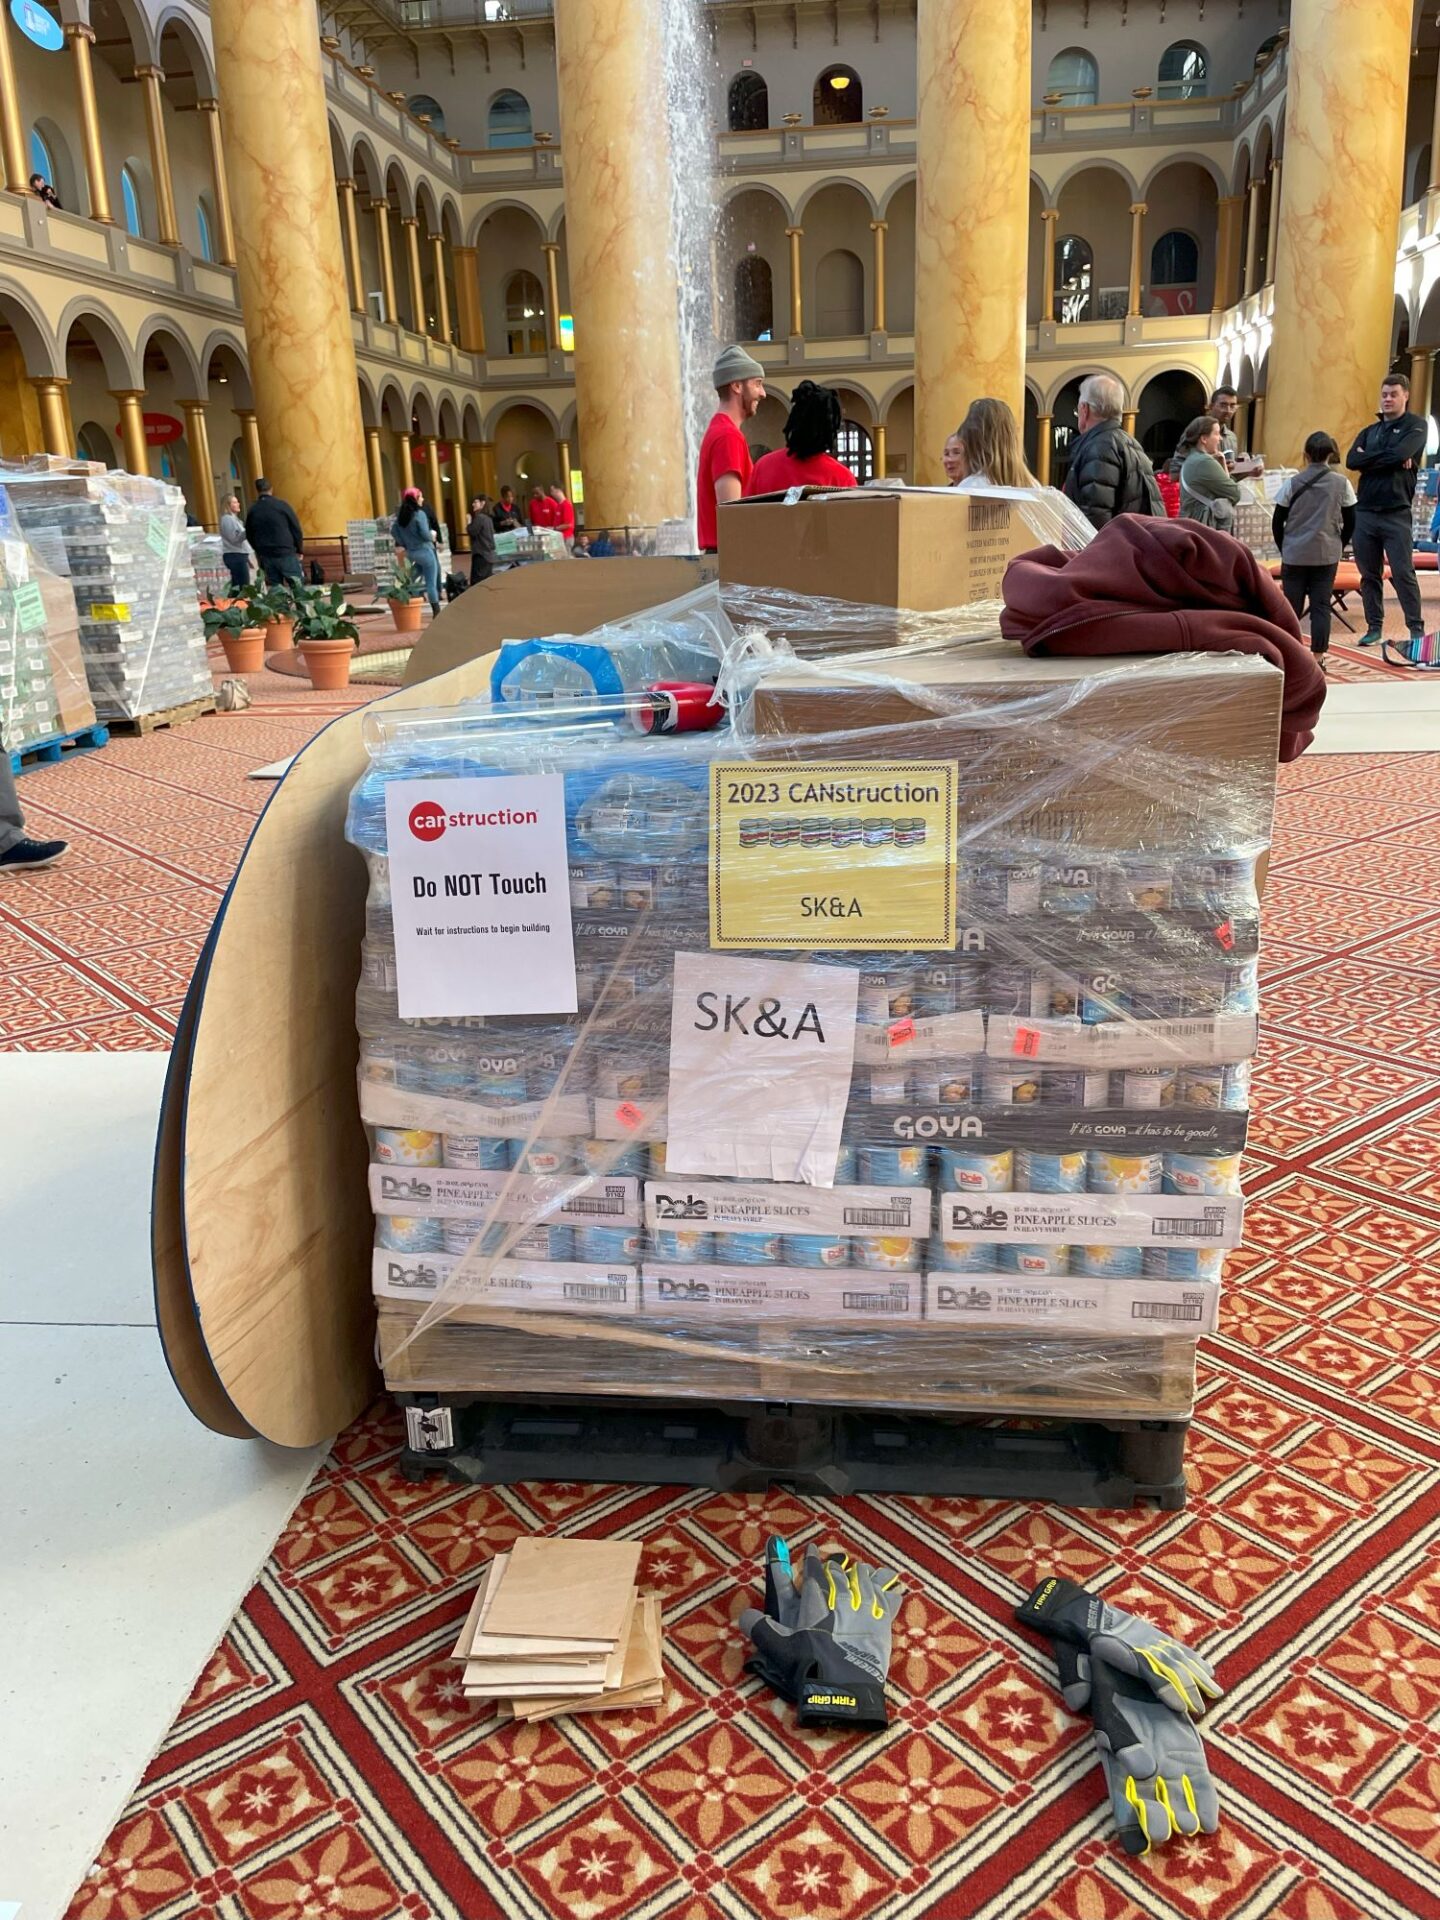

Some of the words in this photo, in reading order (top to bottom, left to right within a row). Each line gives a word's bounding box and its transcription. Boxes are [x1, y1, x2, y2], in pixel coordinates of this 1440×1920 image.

[728, 783, 780, 803] 2023
[788, 782, 939, 803] CANstruction
[414, 808, 538, 830] canstruction
[413, 875, 437, 898] Do
[444, 873, 483, 897] NOT
[488, 871, 547, 895] Touch
[800, 896, 863, 918] SK&A
[416, 926, 433, 936] Wait
[434, 925, 445, 935] for
[446, 925, 489, 935] instructions
[490, 925, 499, 934] to
[500, 923, 520, 935] begin
[522, 922, 551, 934] building
[597, 926, 628, 936] GOYA
[694, 991, 826, 1043] SK&A
[893, 1115, 983, 1139] GOYA
[1069, 1122, 1079, 1136] If
[1094, 1125, 1126, 1135] GOYA
[1143, 1123, 1161, 1136] has
[1163, 1126, 1172, 1136] to
[1174, 1124, 1185, 1136] be
[960, 1171, 983, 1182] Dole
[381, 1175, 432, 1201] Dole
[437, 1186, 493, 1200] PINEAPPLE
[655, 1194, 709, 1219] Dole
[713, 1204, 772, 1215] PINEAPPLE
[773, 1206, 811, 1216] SLICES
[952, 1205, 1008, 1230] Dole
[1014, 1215, 1076, 1226] PINEAPPLE
[1077, 1215, 1117, 1227] SLICES
[1023, 1257, 1046, 1268] Dole
[388, 1262, 437, 1288] Dole
[498, 1277, 533, 1290] SLICES
[658, 1278, 710, 1302] Dole
[715, 1287, 771, 1298] PINEAPPLE
[773, 1289, 810, 1300] SLICES
[937, 1285, 992, 1311] Dole
[997, 1295, 1058, 1308] PINEAPPLE
[1059, 1297, 1098, 1309] SLICES
[1033, 1593, 1048, 1610] FIRM
[843, 1651, 885, 1684] GENERAL
[807, 1694, 831, 1705] GRIP
[831, 1695, 856, 1707] FIRM
